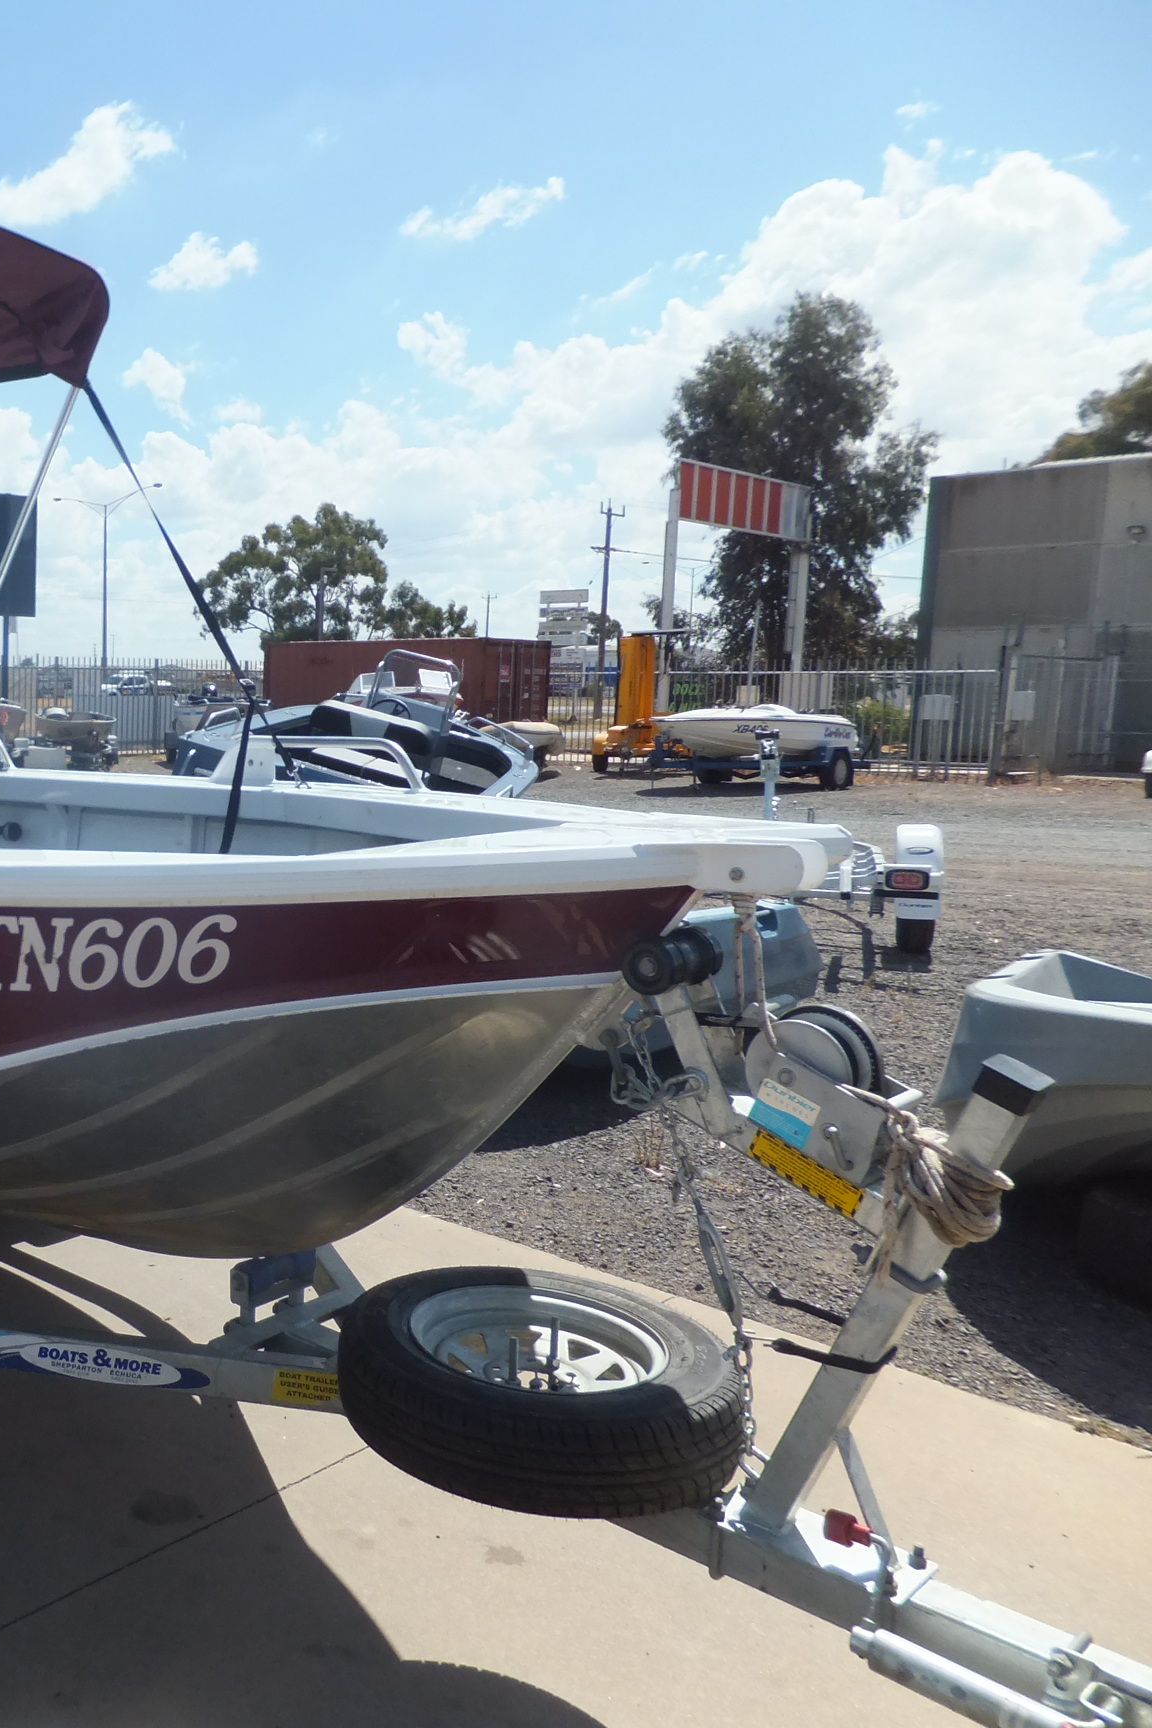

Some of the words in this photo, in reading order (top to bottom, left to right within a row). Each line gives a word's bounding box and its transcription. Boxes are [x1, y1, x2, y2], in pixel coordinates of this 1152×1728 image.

[37, 1346, 89, 1365] BOATS
[92, 1348, 112, 1369] &
[113, 1358, 163, 1376] MORE
[50, 1360, 103, 1374] SHEPPARTON
[109, 1369, 143, 1380] ECHUCA
[279, 1371, 302, 1380] BOAT
[286, 1390, 331, 1402] ATTACHED
